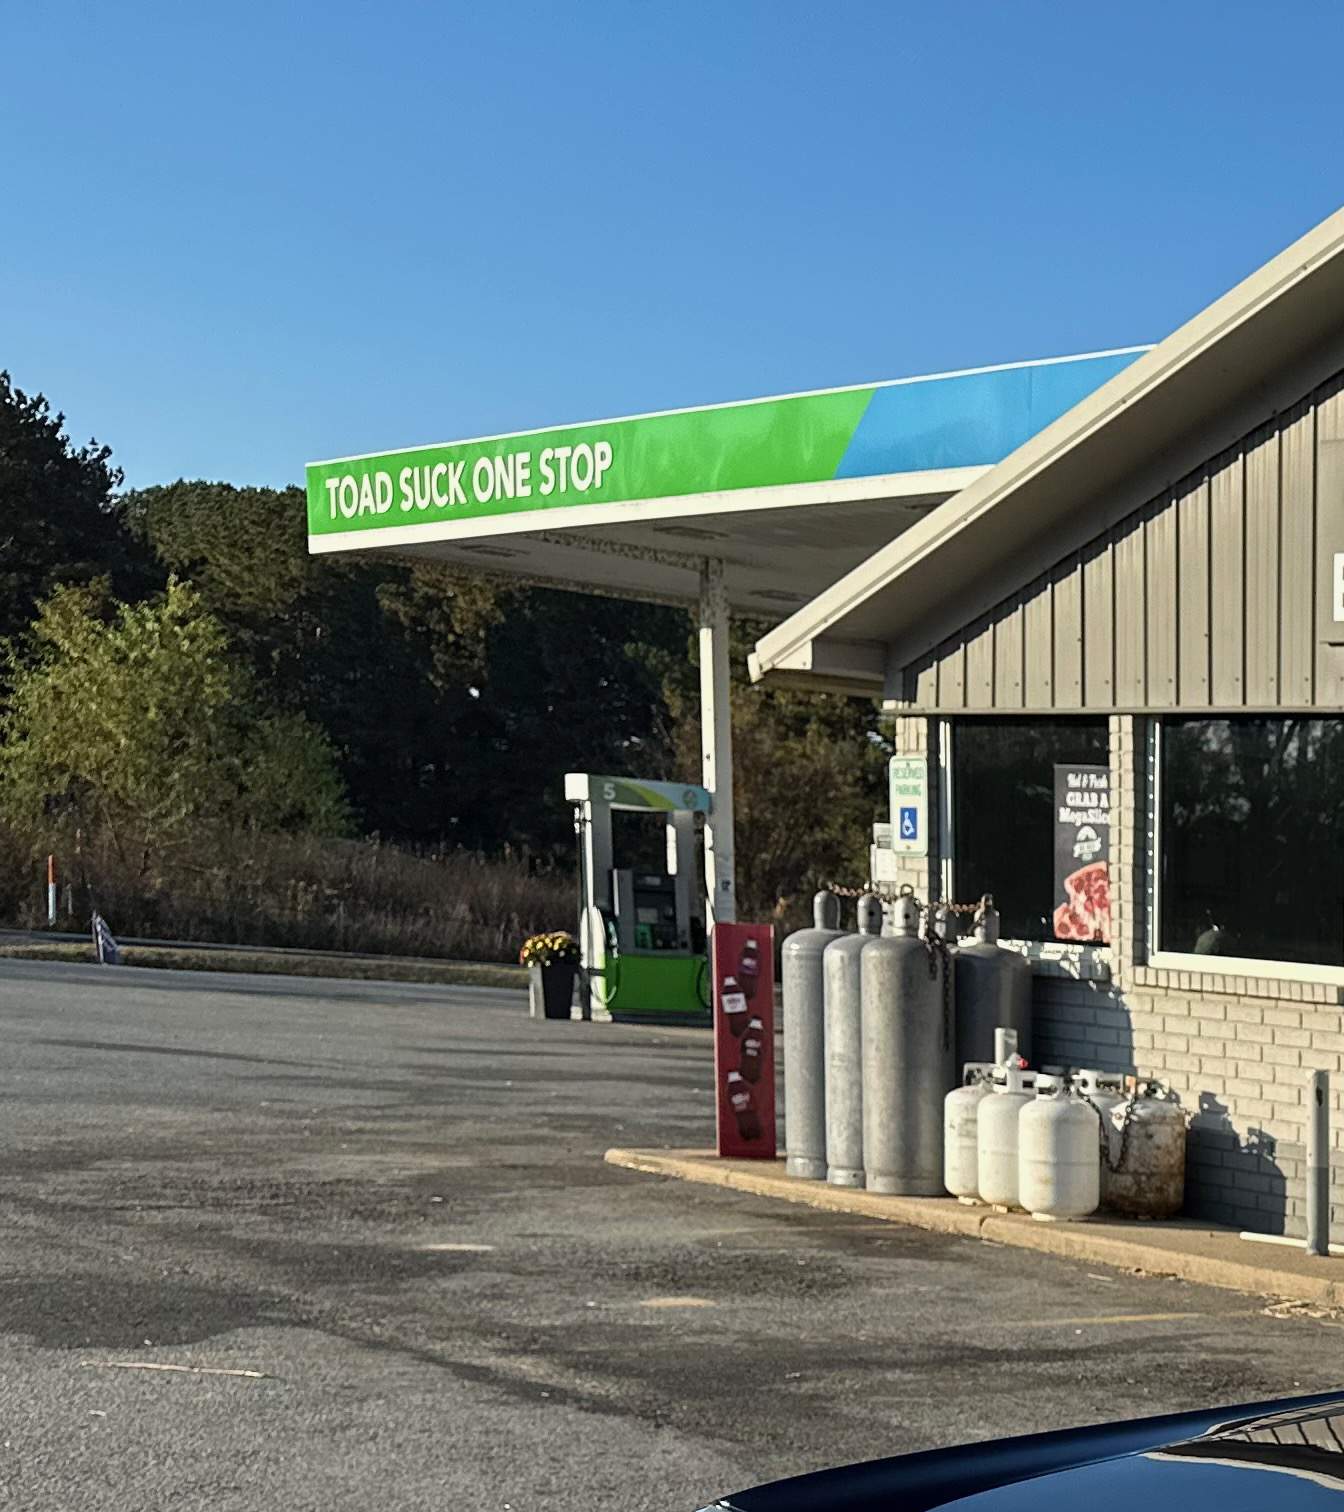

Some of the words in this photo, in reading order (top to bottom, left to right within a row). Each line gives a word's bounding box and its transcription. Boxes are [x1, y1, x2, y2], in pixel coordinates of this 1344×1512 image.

[325, 471, 394, 521] TOAD
[399, 460, 467, 512] SUCK
[472, 454, 532, 503] ONE
[539, 441, 613, 497] STOP
[604, 783, 616, 800] 5
